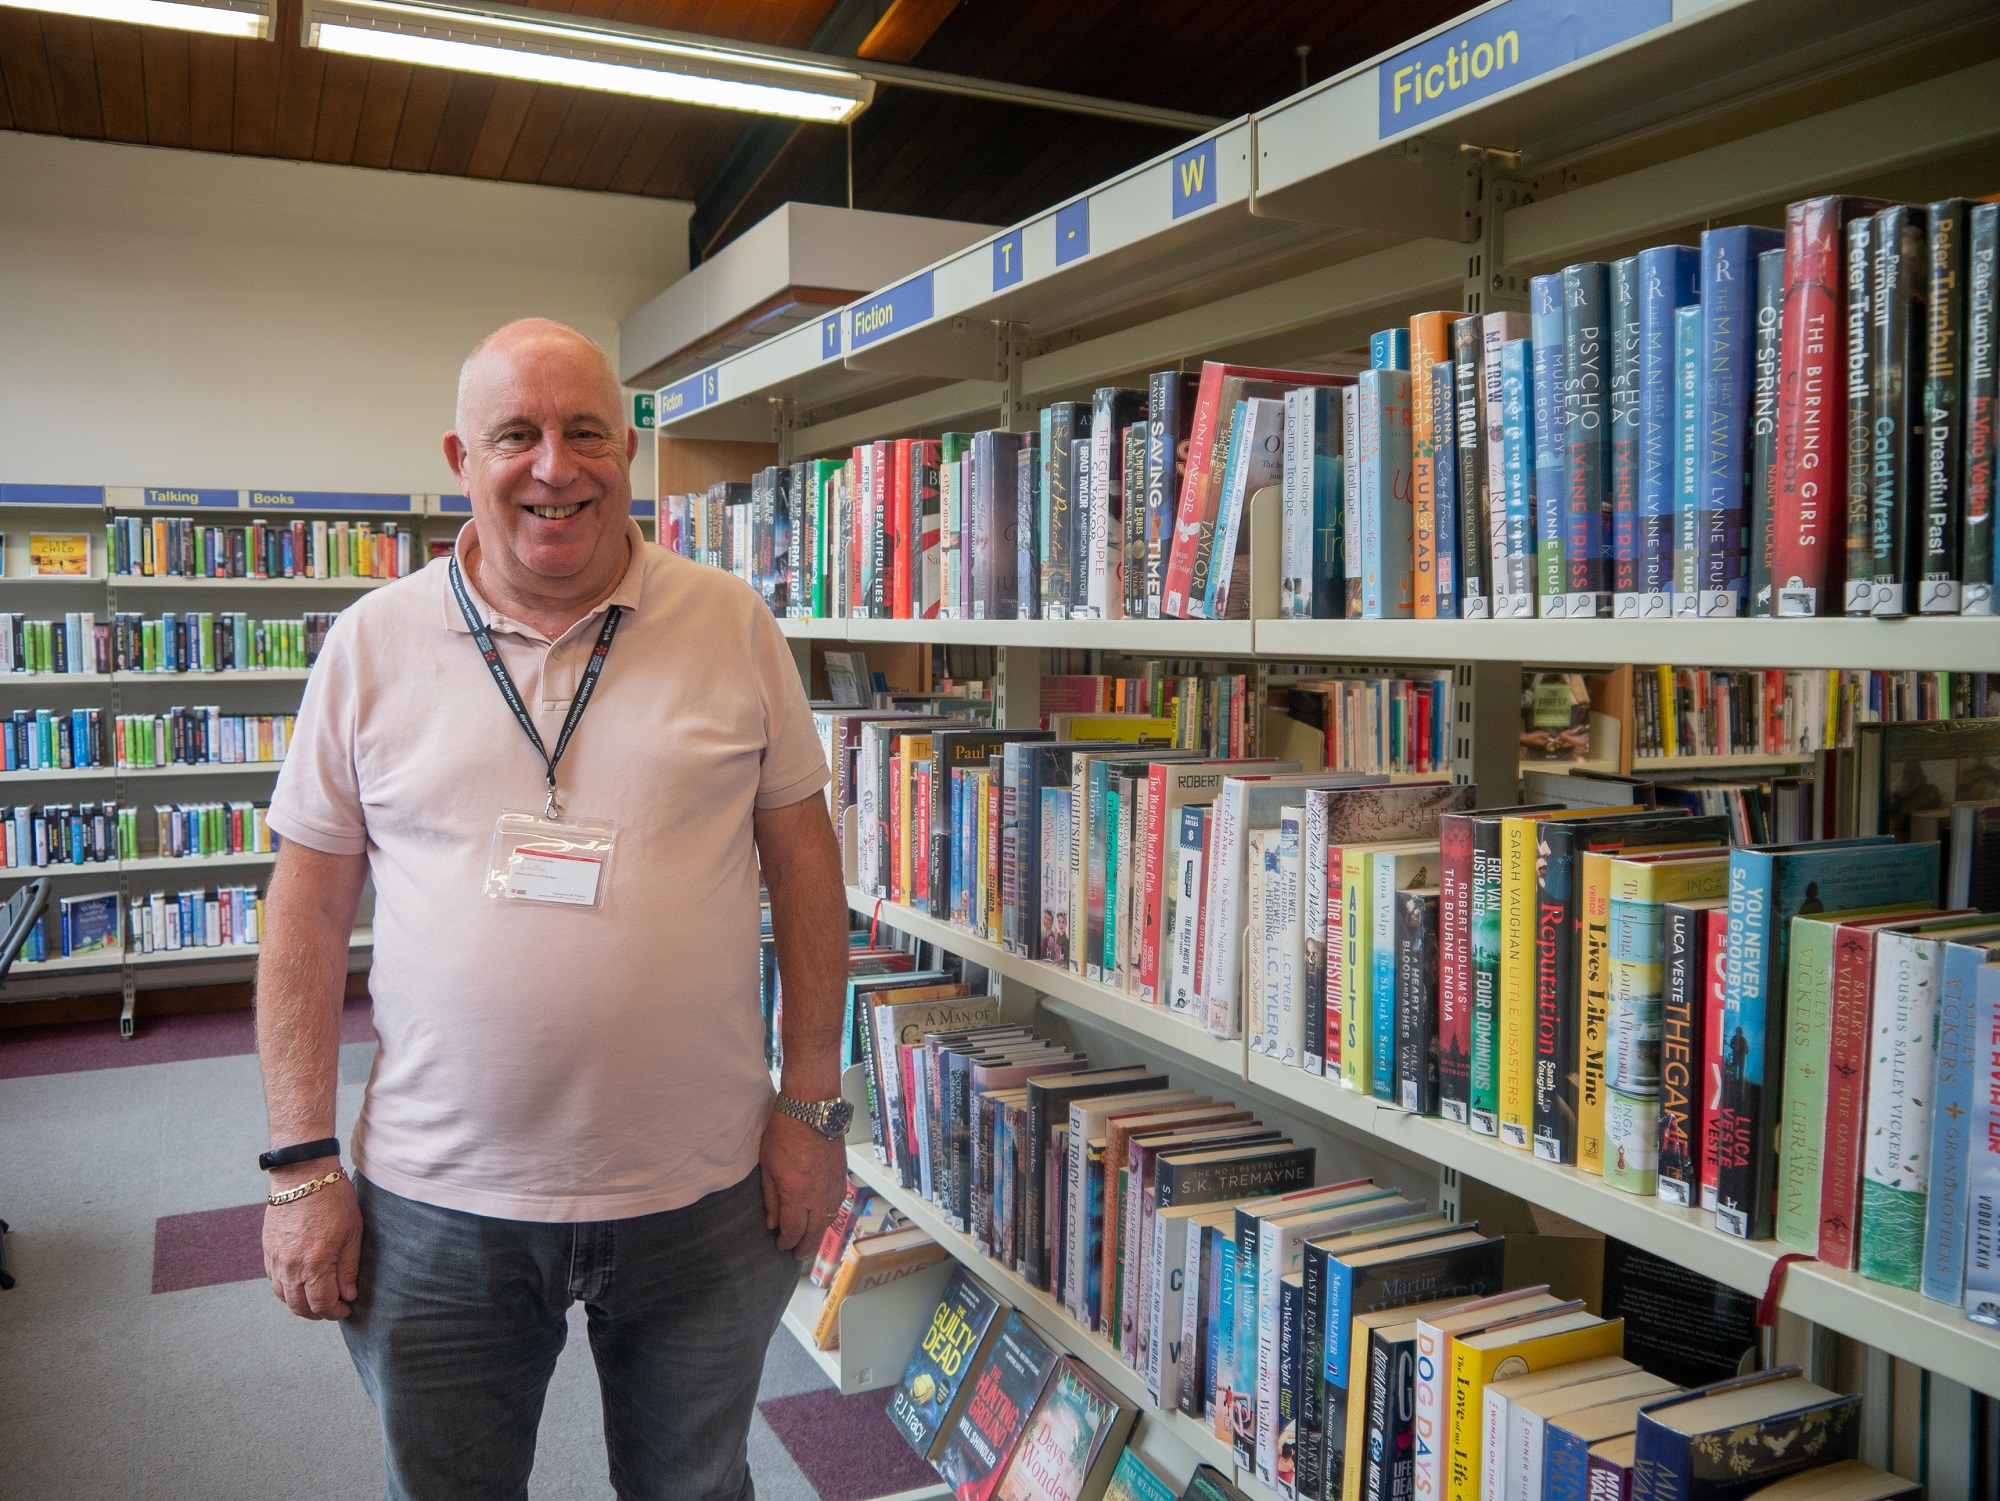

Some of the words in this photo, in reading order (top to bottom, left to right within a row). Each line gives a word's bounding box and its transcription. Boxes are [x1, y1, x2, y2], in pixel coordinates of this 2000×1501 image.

[1394, 28, 1519, 114] Fiction
[1002, 243, 1013, 274] T
[1181, 154, 1206, 197] W
[1849, 230, 1869, 293] Peter
[1933, 218, 1953, 268] Peter
[827, 323, 836, 346] T
[854, 302, 894, 335] Fiction
[1757, 306, 1776, 339] OF
[1808, 314, 1824, 354] THE
[1928, 271, 1955, 377] Turnbull
[1849, 296, 1869, 399] Turnbull
[662, 392, 683, 413] Fiction
[708, 376, 715, 395] S
[1411, 341, 1423, 434] TROLLOPE
[1424, 349, 1436, 425] JOANNA
[1581, 326, 1600, 430] PSYCHO
[1756, 343, 1775, 435] SPRING
[1287, 413, 1298, 461] Joanna
[1302, 411, 1311, 462] Joanna
[1347, 409, 1357, 459] Joanna
[1433, 378, 1442, 453] TROLLOPE
[1443, 383, 1452, 445] JOANNA
[1803, 365, 1823, 469] BURNING
[876, 450, 884, 475] ALL
[1099, 427, 1109, 456] THE
[1150, 421, 1165, 508] SAVING
[1873, 416, 1894, 478] Cold
[149, 490, 199, 505] Talking
[253, 493, 295, 504] Books
[876, 477, 884, 500] THE
[1097, 460, 1108, 510] GUILTY
[1286, 465, 1297, 517] Trollope
[1300, 465, 1310, 517] Trollope
[1347, 463, 1356, 516] Trollope
[1570, 443, 1587, 512] LYNNE
[1615, 440, 1631, 511] LYNNE
[875, 505, 884, 574] BEAUTIFUL
[1800, 481, 1818, 547] GIRLS
[1873, 481, 1894, 559] Wrath
[791, 519, 800, 566] STORM
[1095, 512, 1107, 576] COUPLE
[1147, 538, 1161, 596] TIME
[1571, 519, 1588, 589] TRUSS
[1616, 517, 1633, 589] TRUSS
[790, 570, 799, 600] TIDE
[875, 578, 883, 603] LIES
[568, 703, 584, 728] Volunteer
[578, 677, 594, 704] Lancashire
[838, 726, 848, 786] Danielle
[955, 745, 985, 759] Paul
[989, 793, 997, 816] JOE
[1150, 775, 1160, 794] The
[1178, 774, 1221, 789] ROBERT
[837, 789, 846, 827] Steel
[920, 808, 926, 817] WE
[1149, 797, 1159, 831] Marlow
[1185, 817, 1199, 828] ARISES
[989, 820, 997, 868] THOMAS
[1147, 833, 1158, 869] Murder
[1509, 829, 1522, 882] SARAH
[988, 873, 996, 912] GRINGA
[1146, 872, 1154, 893] Club
[1443, 868, 1455, 898] THE
[1473, 848, 1486, 919] LUSTBADER
[1487, 857, 1502, 885] ERIC
[1686, 879, 1723, 894] INGA
[1731, 867, 1746, 910] SAID
[1487, 887, 1502, 912] VAN
[1508, 884, 1521, 961] VAUGHAN
[1746, 888, 1763, 925] YOU
[1443, 903, 1455, 958] BOURNE
[1588, 921, 1608, 983] Lives
[1673, 915, 1685, 954] LUCA
[1476, 970, 1493, 1005] FOUR
[1538, 902, 1565, 1056] Reputation
[1671, 957, 1684, 1004] VESTE
[1726, 914, 1744, 1013] GOODBYE
[1742, 928, 1762, 999] NEVER
[1443, 964, 1455, 1023] ENIGMA
[1508, 965, 1520, 1017] LITTLE
[1586, 986, 1606, 1041] Like
[1794, 948, 1814, 1048] VICKERS
[1834, 965, 1853, 1049] VICKERS
[1896, 958, 1909, 1034] cousins
[926, 1011, 935, 1026] A
[939, 1010, 965, 1023] MAN
[975, 1010, 991, 1021] OF
[1940, 978, 1963, 1085] VICKERS
[859, 1025, 867, 1052] CALL
[866, 1077, 874, 1113] SHOTS
[1474, 1008, 1493, 1092] DOMINIONS
[1507, 1021, 1519, 1106] DISASTERS
[1584, 1045, 1606, 1107] Mine
[1891, 1040, 1907, 1098] SALLEY
[1070, 1118, 1080, 1139] P.J.
[1733, 1114, 1751, 1168] LUCA
[1887, 1102, 1903, 1171] VICKERS
[1068, 1141, 1080, 1189] TRACY
[1181, 1179, 1212, 1194] S.K.
[1219, 1167, 1306, 1190] TREMAYNE
[1787, 1099, 1808, 1218] LIBRARIAN
[1069, 1192, 1077, 1211] ICE
[1937, 1126, 1960, 1275] GRANDMOTHERS
[1067, 1213, 1077, 1250] COLD
[1976, 1195, 1992, 1271] VODOLAZKIN
[862, 1260, 929, 1288] NINE
[1065, 1252, 1076, 1293] HEART
[1382, 1276, 1436, 1298] Martin
[922, 1324, 961, 1377] DEAD
[934, 1302, 977, 1356] GUILTY
[1418, 1332, 1435, 1407] DOG
[894, 1392, 908, 1416] P.J.
[905, 1406, 927, 1442] Tracy
[968, 1395, 1008, 1450] GROUND
[974, 1371, 1020, 1434] HUNTING
[1456, 1376, 1471, 1421] Love
[959, 1416, 971, 1435] WILL
[969, 1430, 997, 1469] SHINDLER
[1036, 1423, 1067, 1468] Days
[1065, 1466, 1075, 1477] of
[1453, 1433, 1460, 1447] my
[1456, 1421, 1461, 1432] of
[1022, 1444, 1072, 1501] Wonder
[1122, 1463, 1137, 1481] PAM
[1417, 1419, 1433, 1495] DAYS
[1453, 1448, 1468, 1487] Life
